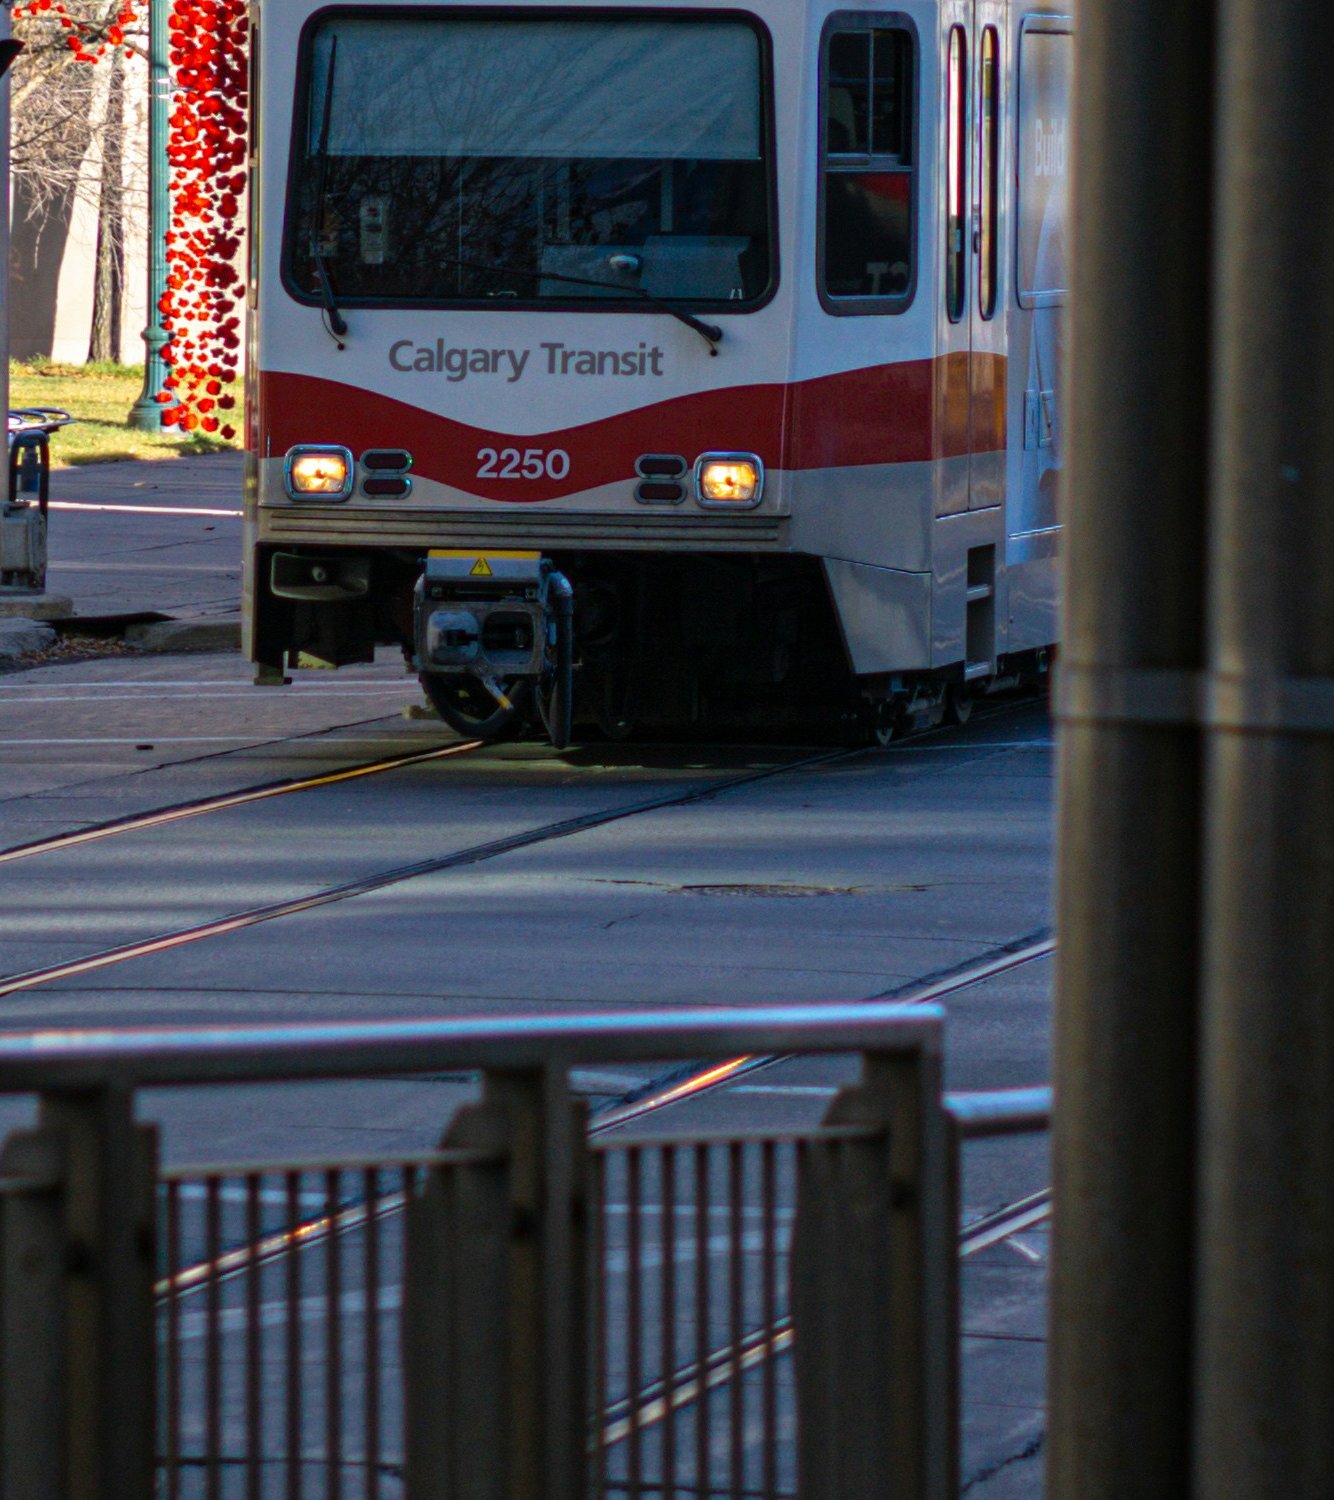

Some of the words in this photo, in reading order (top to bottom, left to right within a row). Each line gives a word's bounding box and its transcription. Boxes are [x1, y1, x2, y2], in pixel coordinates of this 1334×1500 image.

[388, 338, 530, 383] Calgary
[540, 342, 664, 376] Transit
[476, 448, 570, 480] 2250
